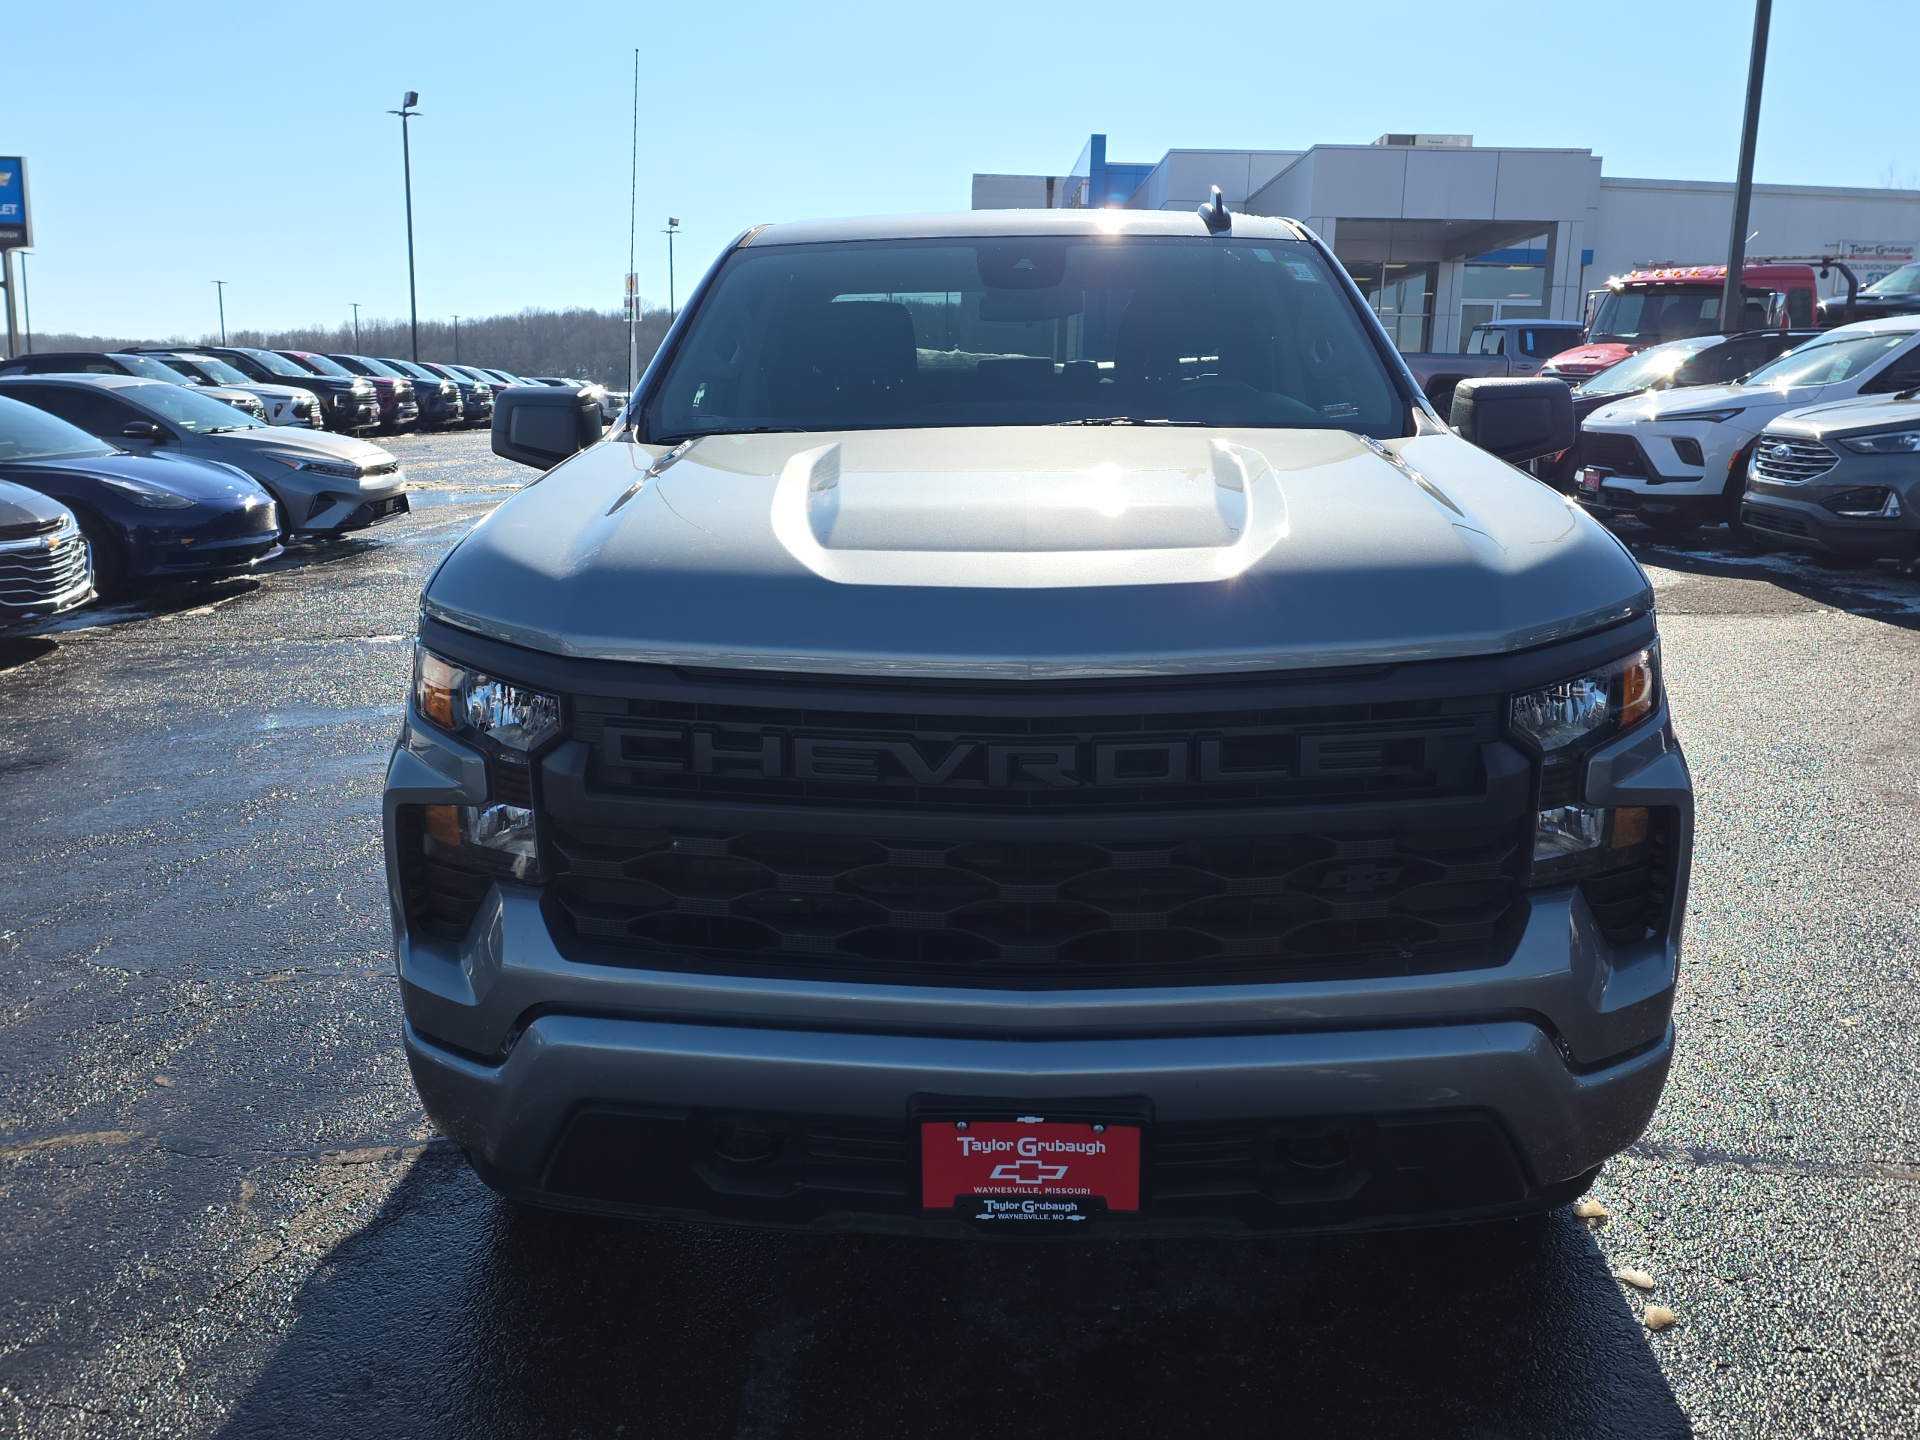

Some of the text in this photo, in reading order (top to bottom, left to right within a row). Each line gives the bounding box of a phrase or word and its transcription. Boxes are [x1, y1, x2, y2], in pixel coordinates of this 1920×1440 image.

[1849, 244, 1874, 254] Taylor
[603, 725, 1475, 787] CHEVROLET
[957, 1137, 1106, 1157] Taylor Grubaugh
[973, 1186, 1091, 1195] WAYNESVILLE, MISSOURI
[984, 1200, 1078, 1213] Taylor Grubaugh
[997, 1213, 1051, 1221] WAYNESVILLE,
